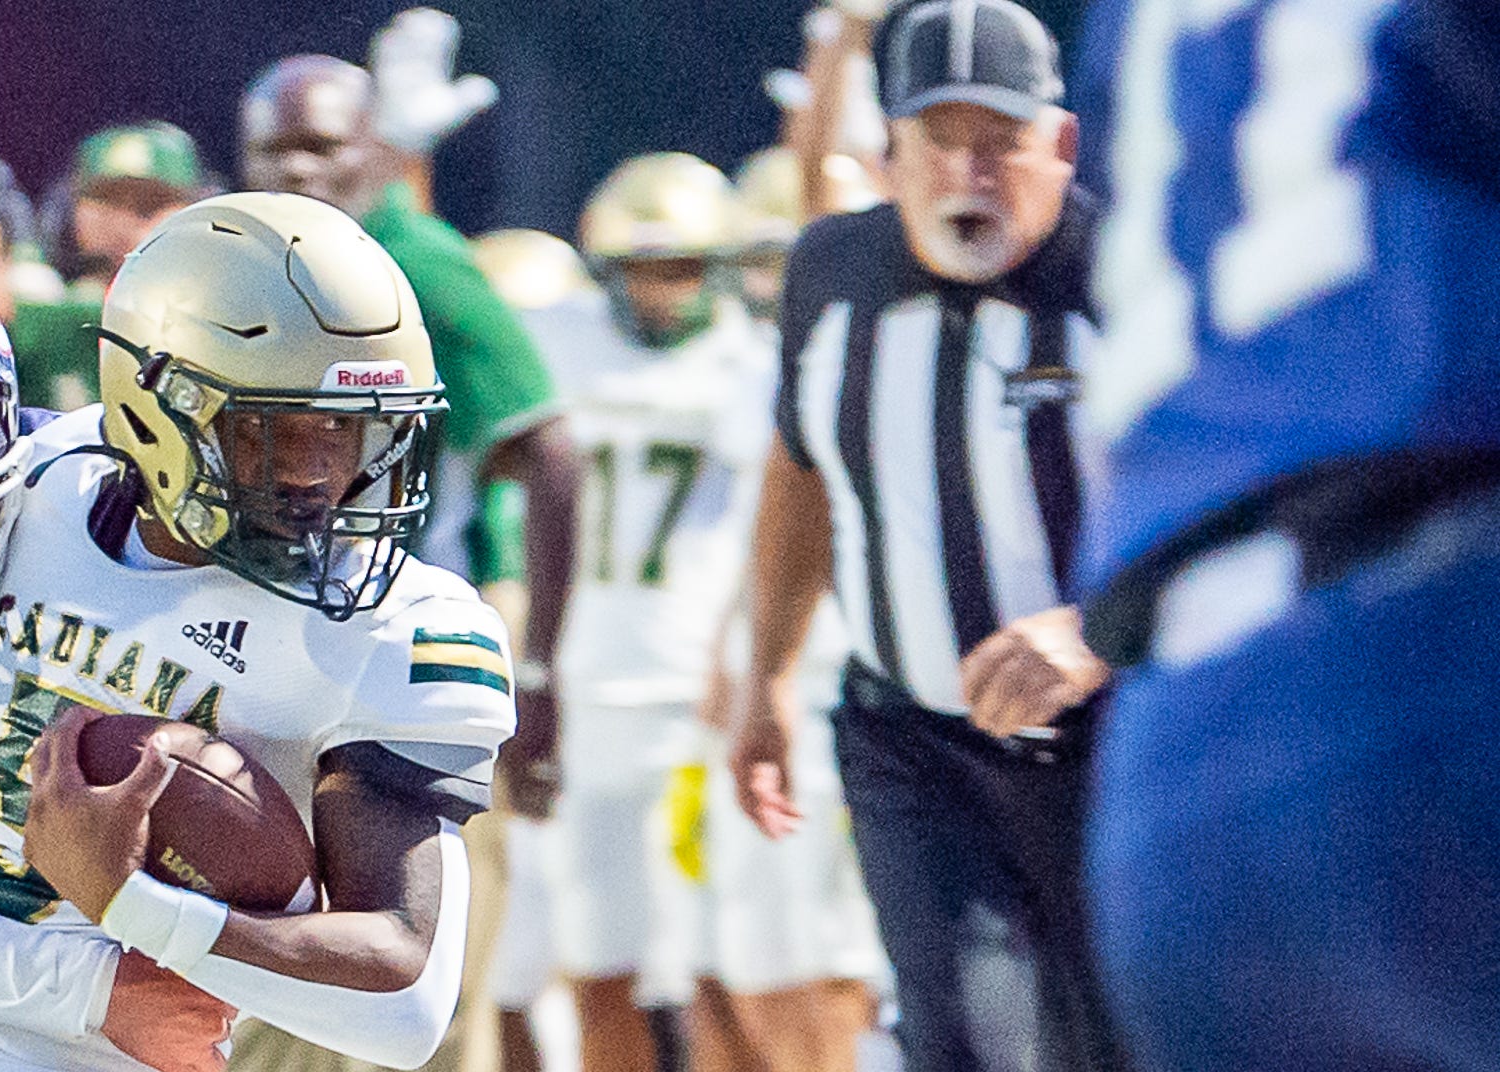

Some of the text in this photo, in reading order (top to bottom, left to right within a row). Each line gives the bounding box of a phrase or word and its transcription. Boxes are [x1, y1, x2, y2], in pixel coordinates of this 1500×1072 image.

[337, 369, 405, 387] Riddell
[584, 440, 704, 586] 17
[181, 624, 246, 675] adidas
